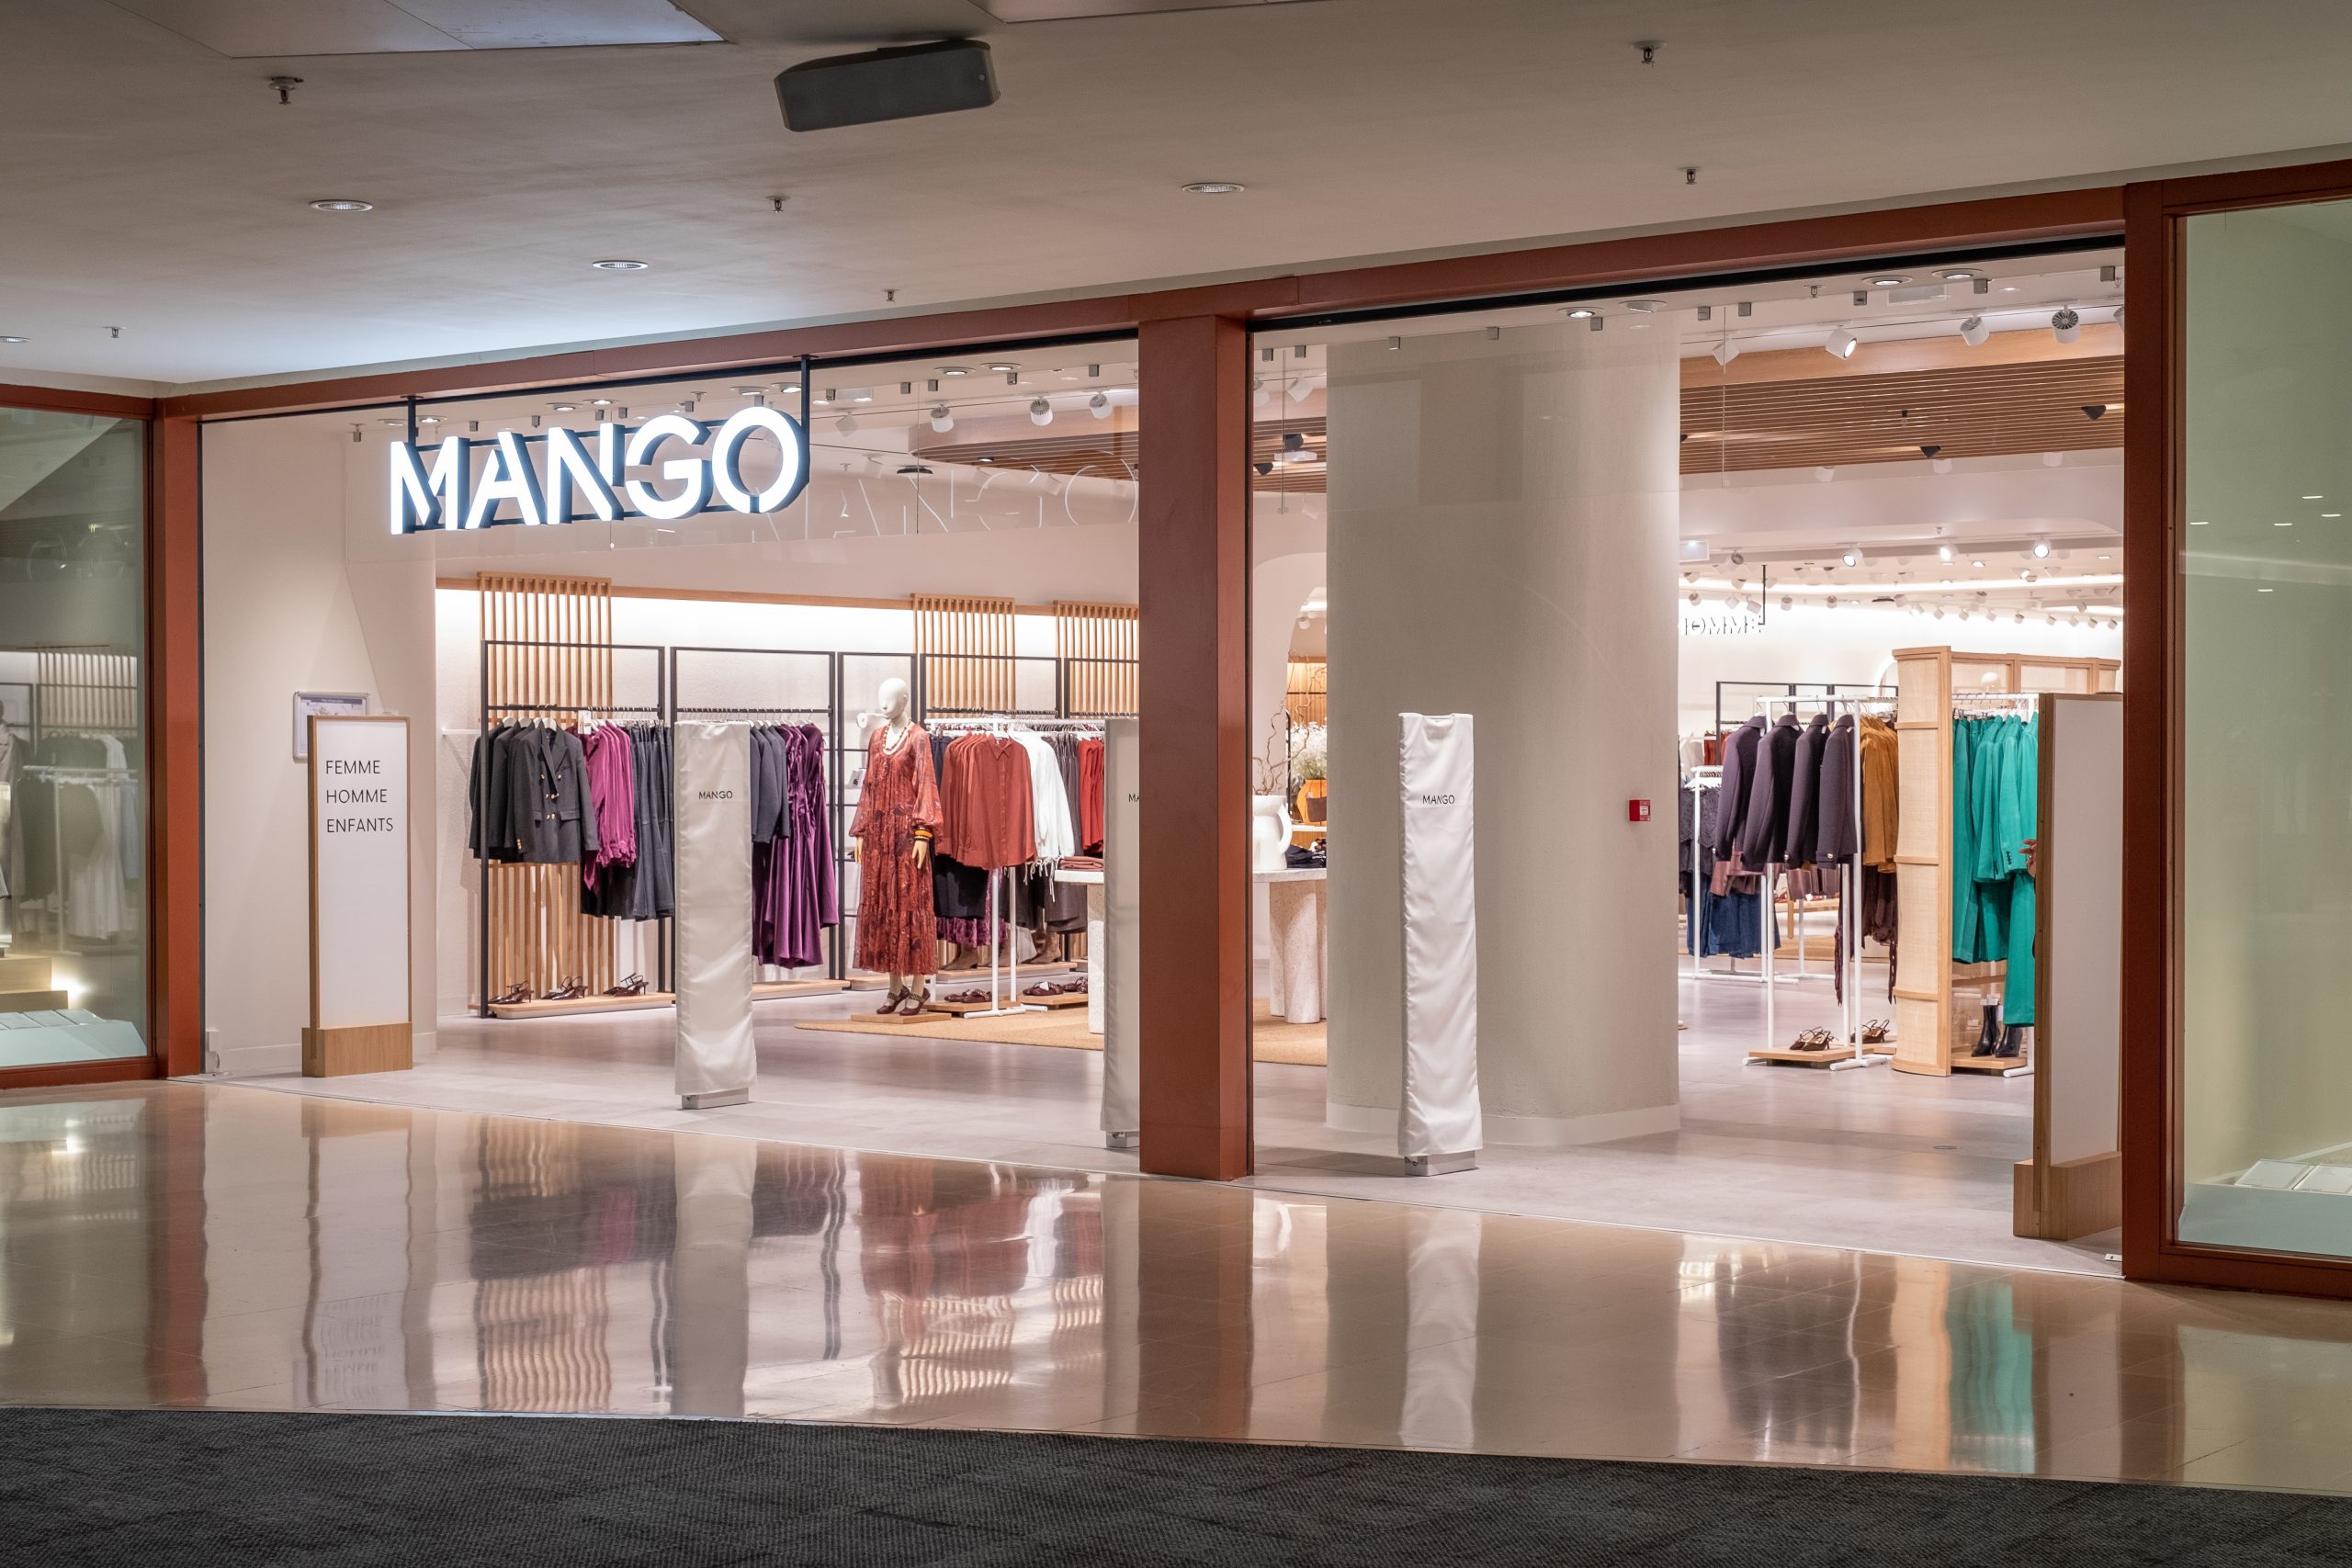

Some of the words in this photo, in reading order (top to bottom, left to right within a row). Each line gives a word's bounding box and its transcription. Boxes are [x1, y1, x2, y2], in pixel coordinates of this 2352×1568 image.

[390, 406, 805, 535] MANGO
[325, 760, 381, 774] FEMME
[326, 788, 388, 804] HOMME
[698, 790, 733, 800] MANGO
[1422, 794, 1455, 805] MANGO
[327, 818, 394, 833] ENFANTS
